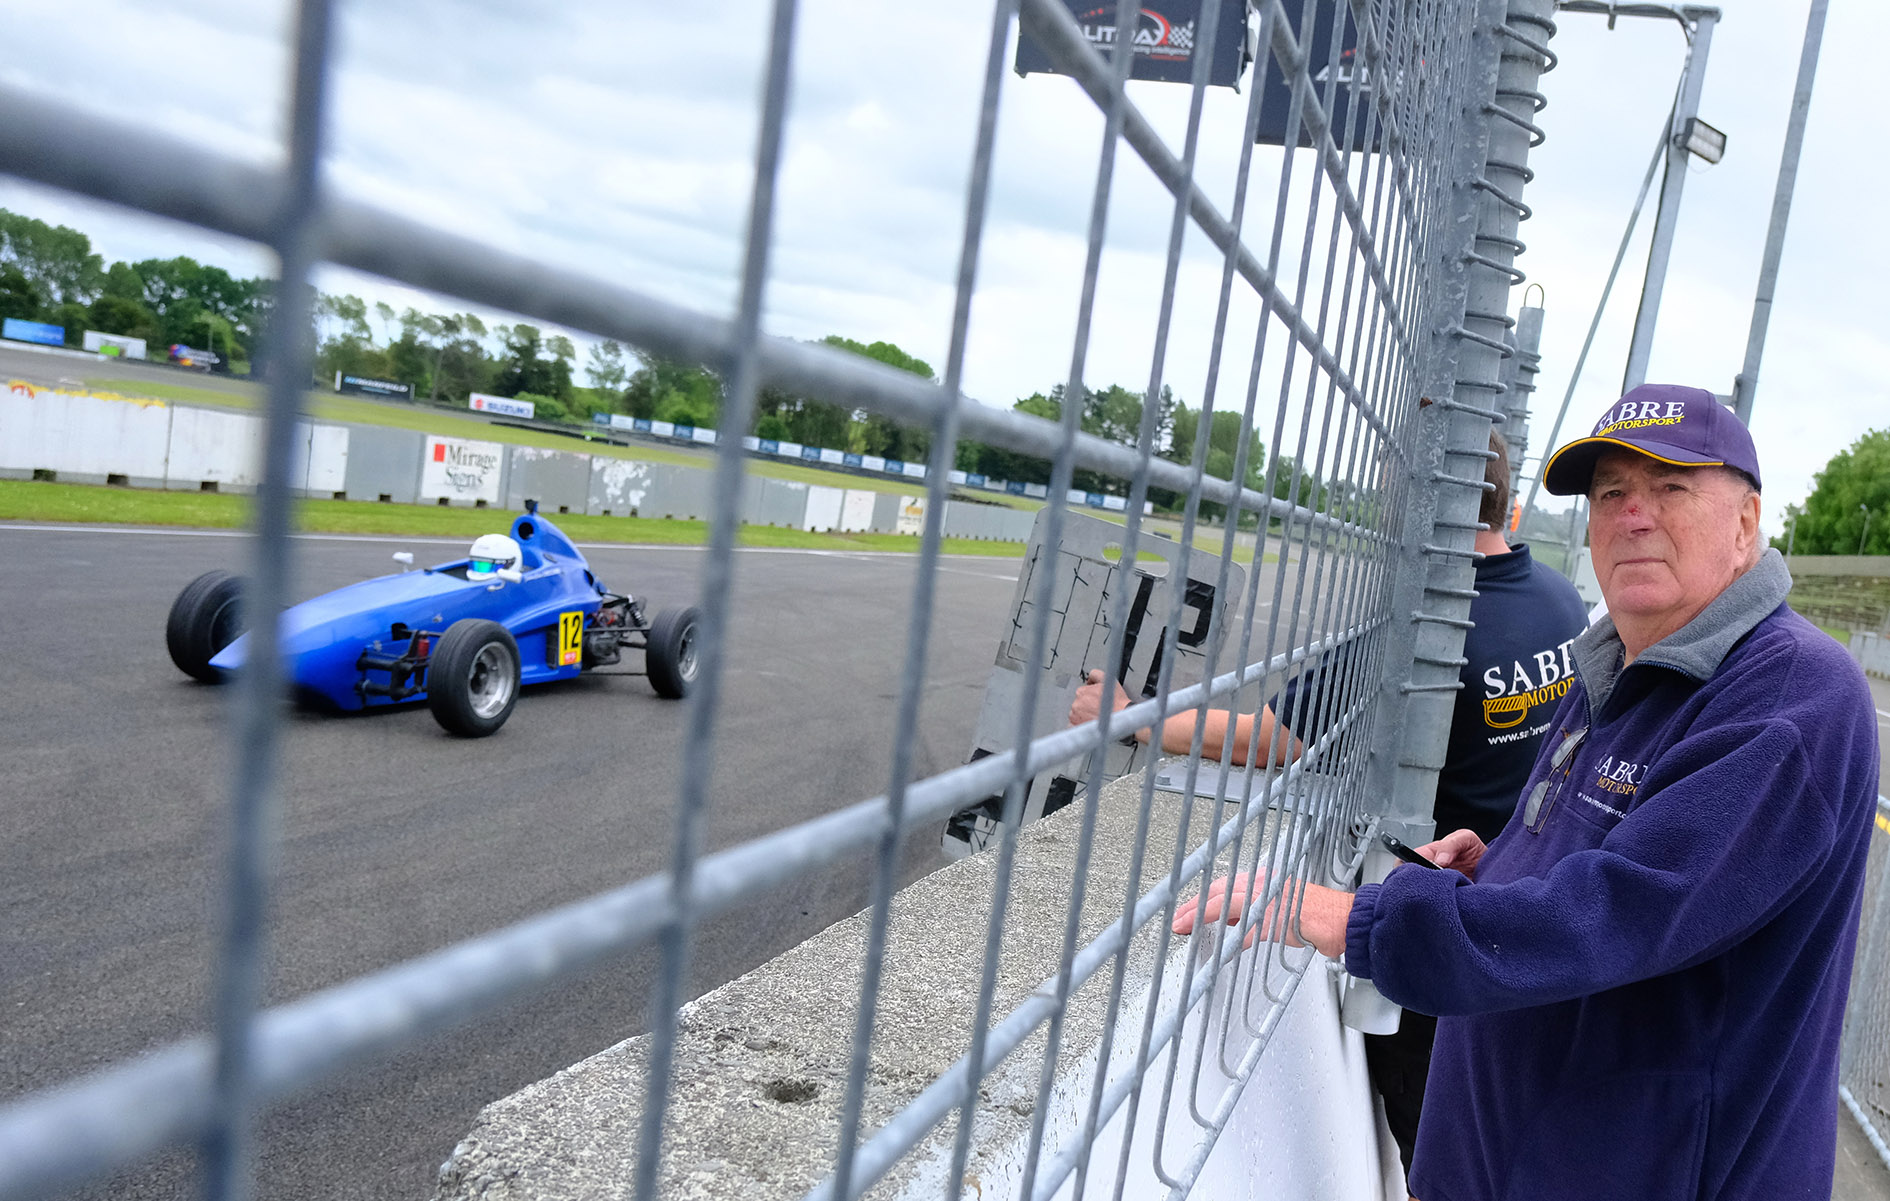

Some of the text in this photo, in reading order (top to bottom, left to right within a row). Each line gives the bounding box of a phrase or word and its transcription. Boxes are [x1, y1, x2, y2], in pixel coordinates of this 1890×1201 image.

[1596, 401, 1685, 436] SABRE
[1597, 415, 1685, 437] MOTORSPORT
[447, 445, 498, 475] Mirage
[444, 466, 484, 493] Signs
[563, 615, 580, 651] 12
[1483, 637, 1576, 699] SABR
